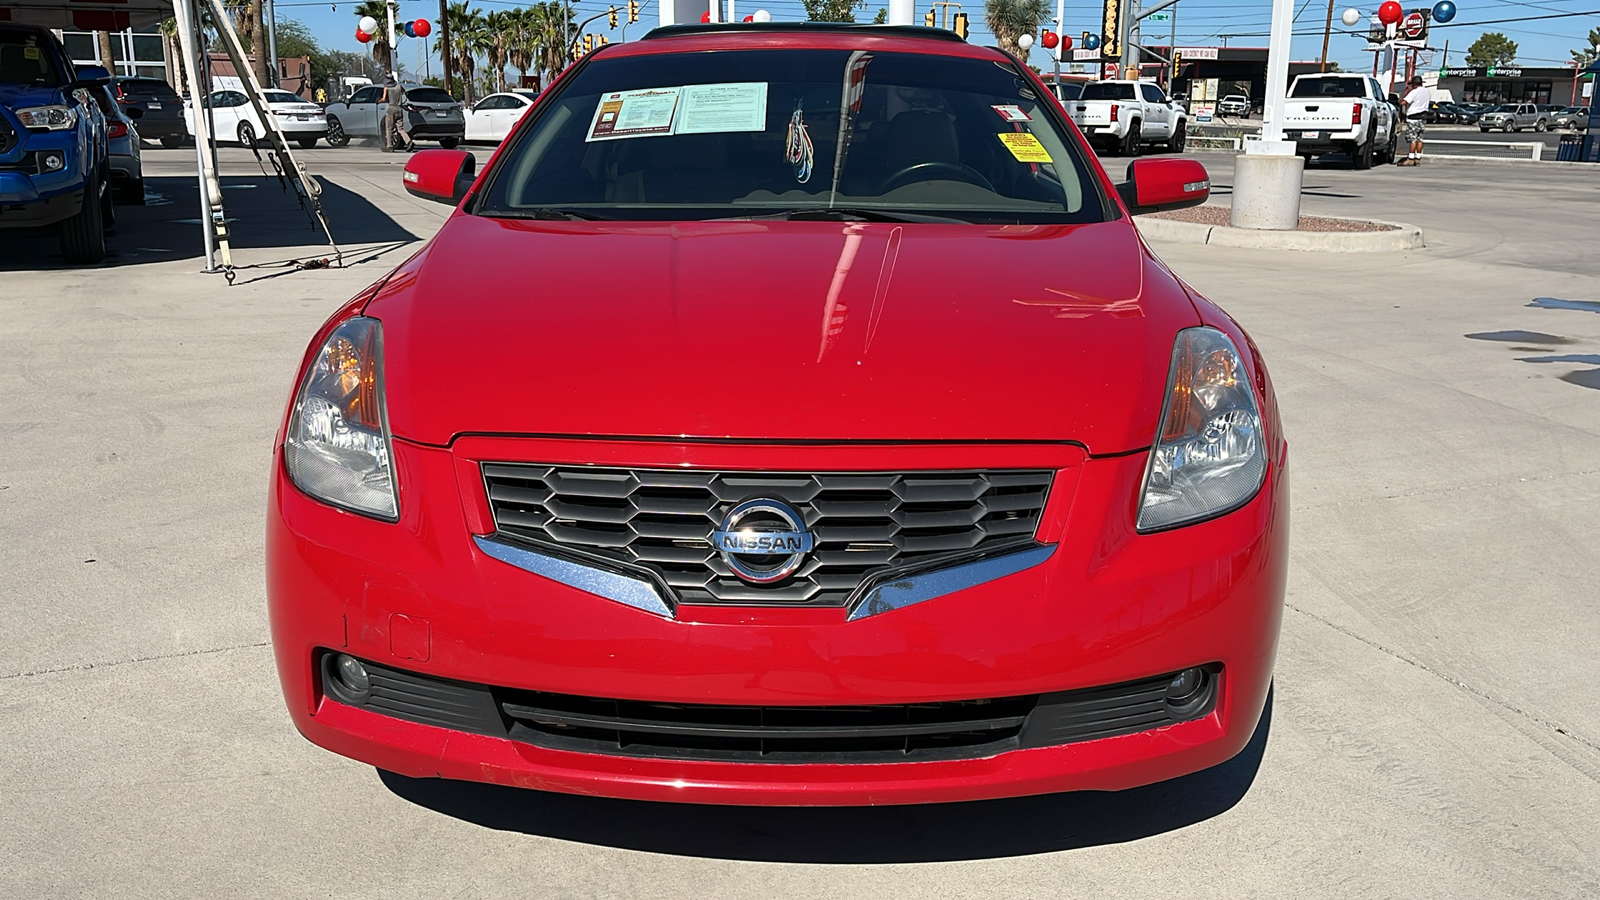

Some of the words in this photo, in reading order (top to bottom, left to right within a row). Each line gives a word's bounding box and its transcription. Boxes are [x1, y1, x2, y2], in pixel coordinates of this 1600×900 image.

[1441, 69, 1476, 77] enterprise
[1489, 68, 1522, 76] enterprise
[723, 536, 802, 550] NISSAN
